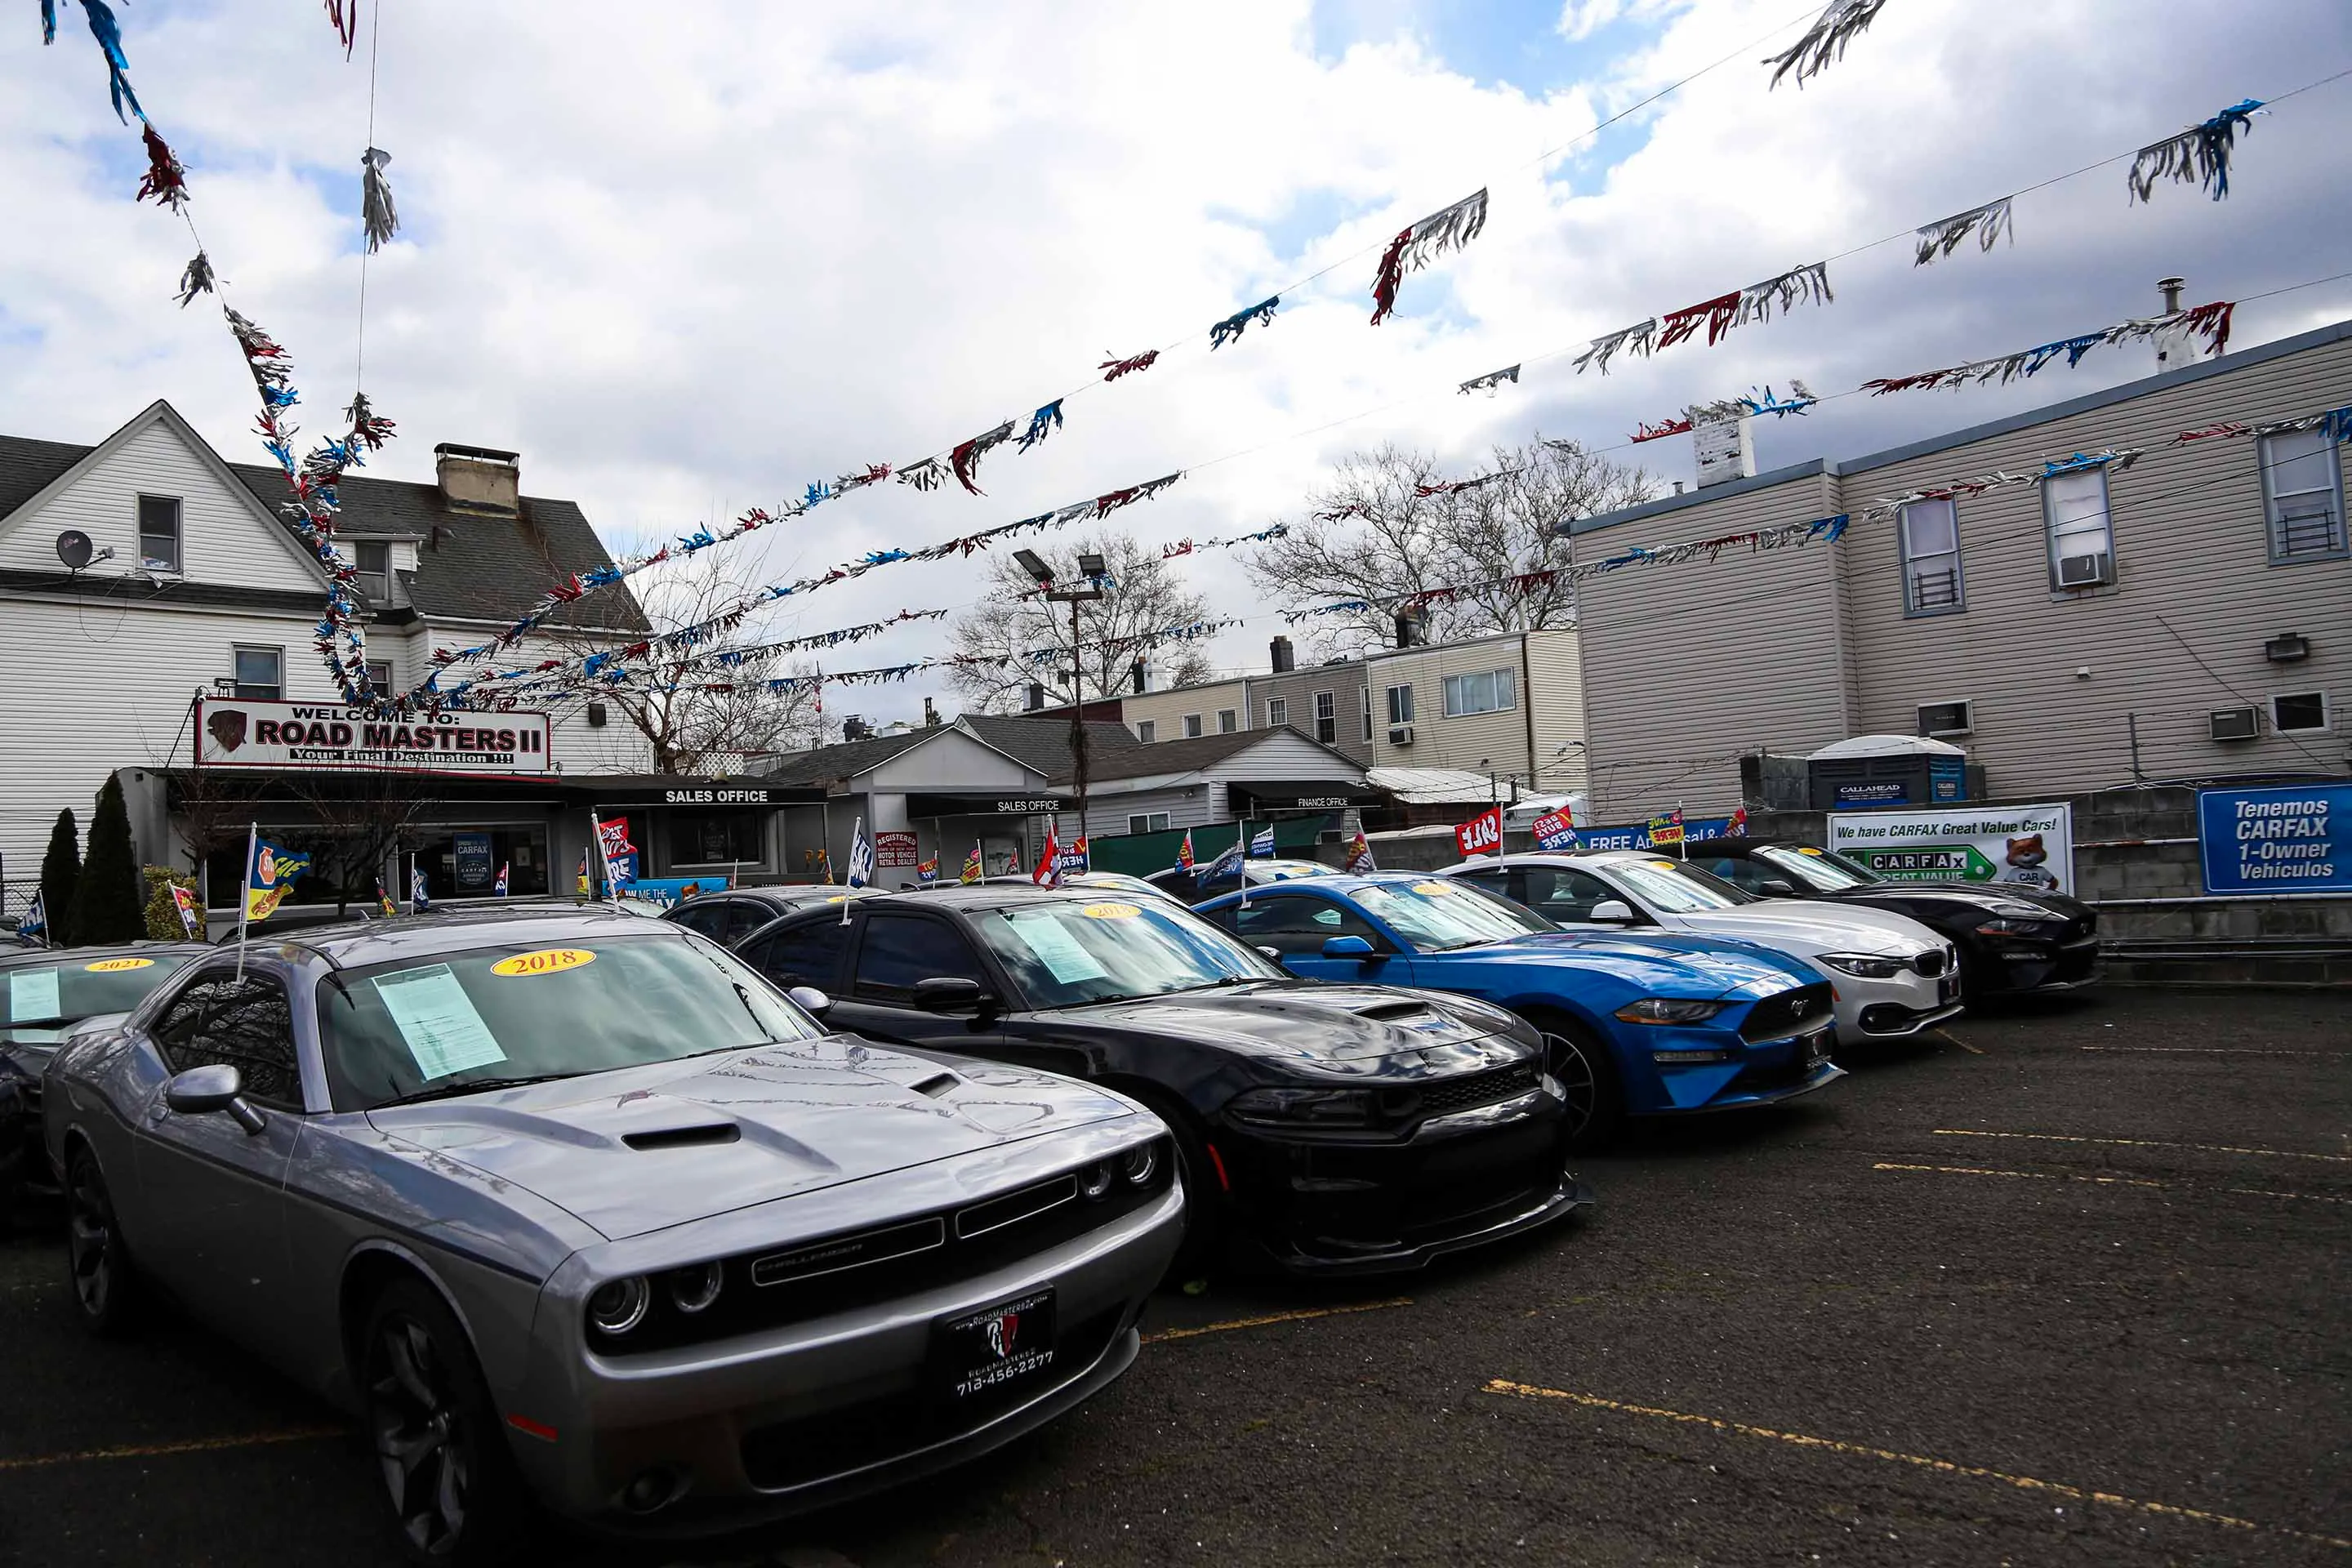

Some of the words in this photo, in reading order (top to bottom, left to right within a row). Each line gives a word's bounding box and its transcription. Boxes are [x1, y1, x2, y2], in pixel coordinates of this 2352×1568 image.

[292, 706, 414, 724] WELCOME
[422, 713, 460, 724] TO:
[255, 719, 353, 747] ROAD
[363, 724, 516, 751] MASTERS
[294, 749, 337, 760] Your
[343, 751, 385, 762] Final
[392, 751, 487, 764] Destination
[1840, 784, 1900, 793] CALLAHEAD
[666, 790, 713, 803] SALES
[717, 790, 768, 803] OFFICE
[1298, 798, 1325, 807] FINANCE
[1326, 797, 1348, 806] OFFICE
[998, 801, 1027, 812] SALES
[1028, 800, 1059, 811] OFFICE
[2234, 800, 2329, 818] Tenemos
[1838, 826, 1855, 838] We
[1857, 825, 1886, 838] have
[1889, 823, 1940, 837] CARFAX
[1942, 822, 1977, 835] Great
[1981, 821, 2018, 834] Value
[2022, 818, 2057, 831] Cars!
[2236, 817, 2329, 840] CARFAX
[877, 834, 916, 846] REGISTERED
[1590, 835, 1631, 850] FREE
[457, 844, 488, 854] CARFAX
[2239, 842, 2332, 861] 1-Owner
[1873, 853, 1967, 870] CARFAX
[2019, 873, 2039, 881] CAR
[2240, 861, 2333, 880] Vehículos
[639, 888, 651, 898] ME
[653, 888, 667, 898] THE
[97, 960, 140, 971] 2021
[512, 951, 577, 974] 2018
